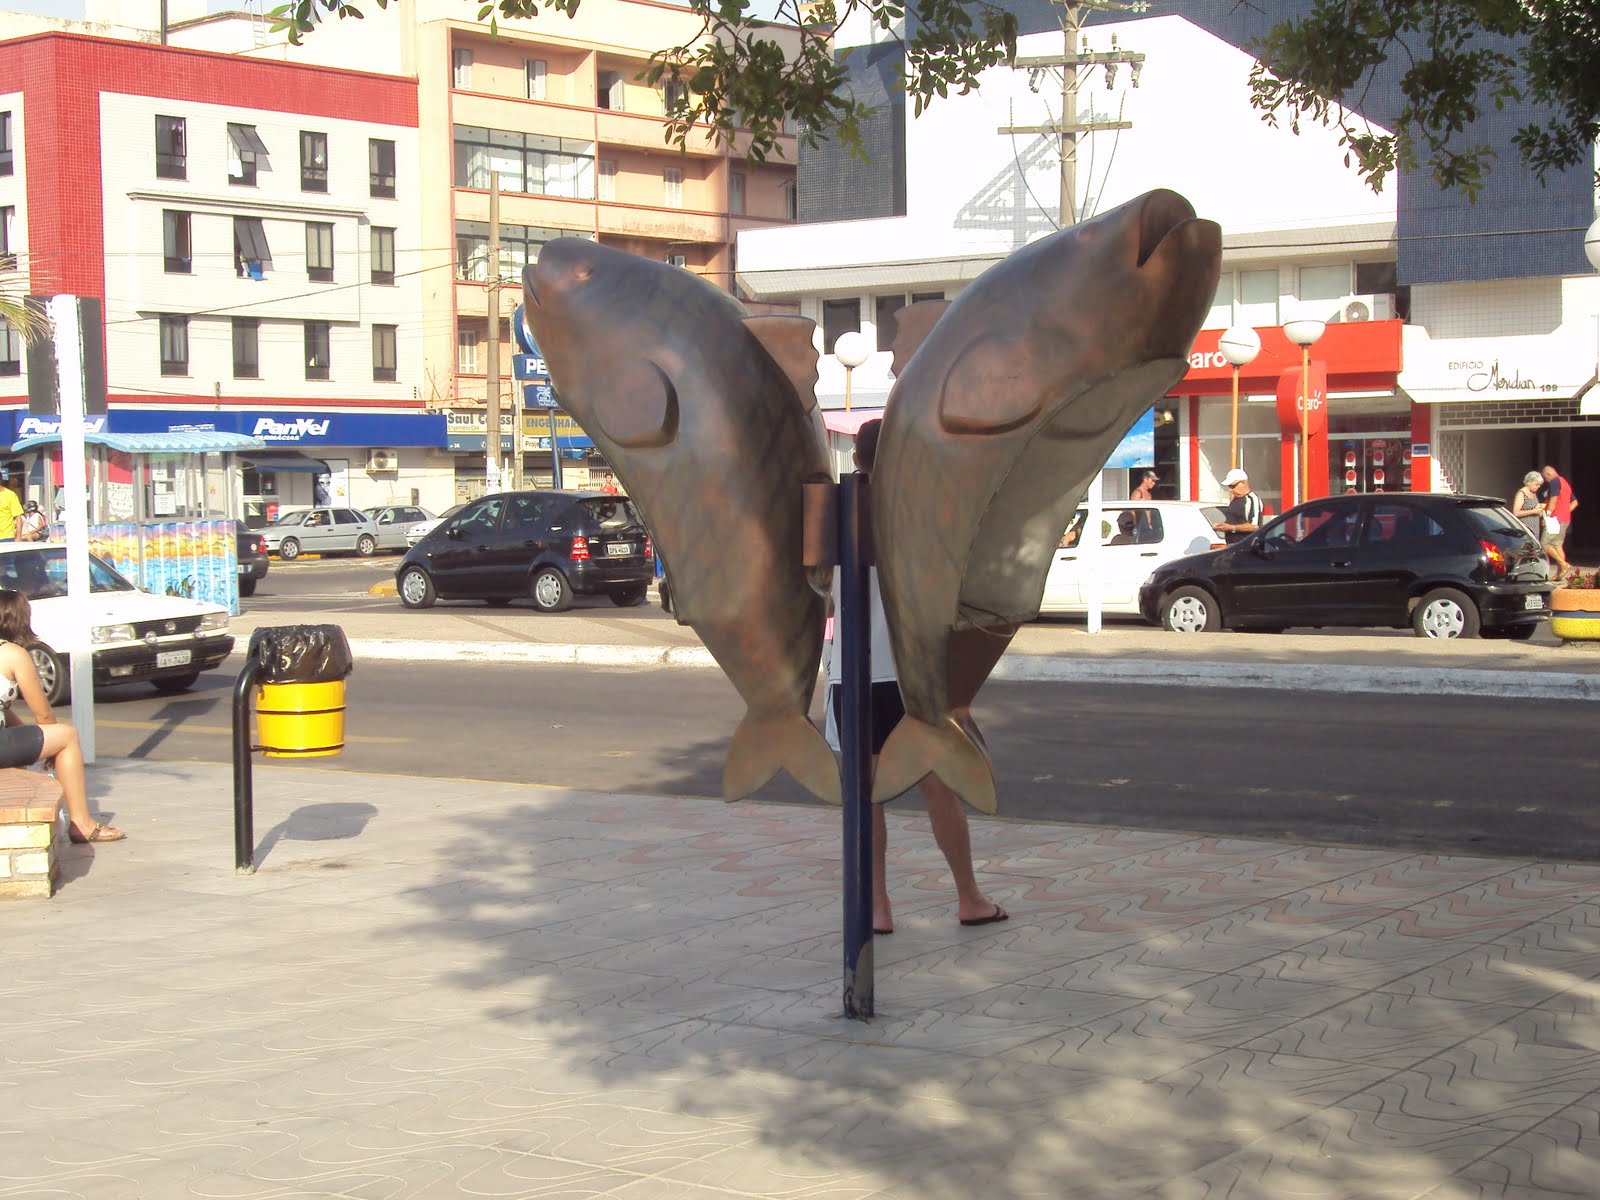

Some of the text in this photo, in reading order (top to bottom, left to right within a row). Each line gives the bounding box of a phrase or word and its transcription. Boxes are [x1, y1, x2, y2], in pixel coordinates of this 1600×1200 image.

[1448, 361, 1484, 370] EDIFICIO
[1540, 384, 1558, 392] 199
[1297, 395, 1320, 410] Caro
[448, 412, 474, 425] Saul
[19, 417, 105, 434] Panel
